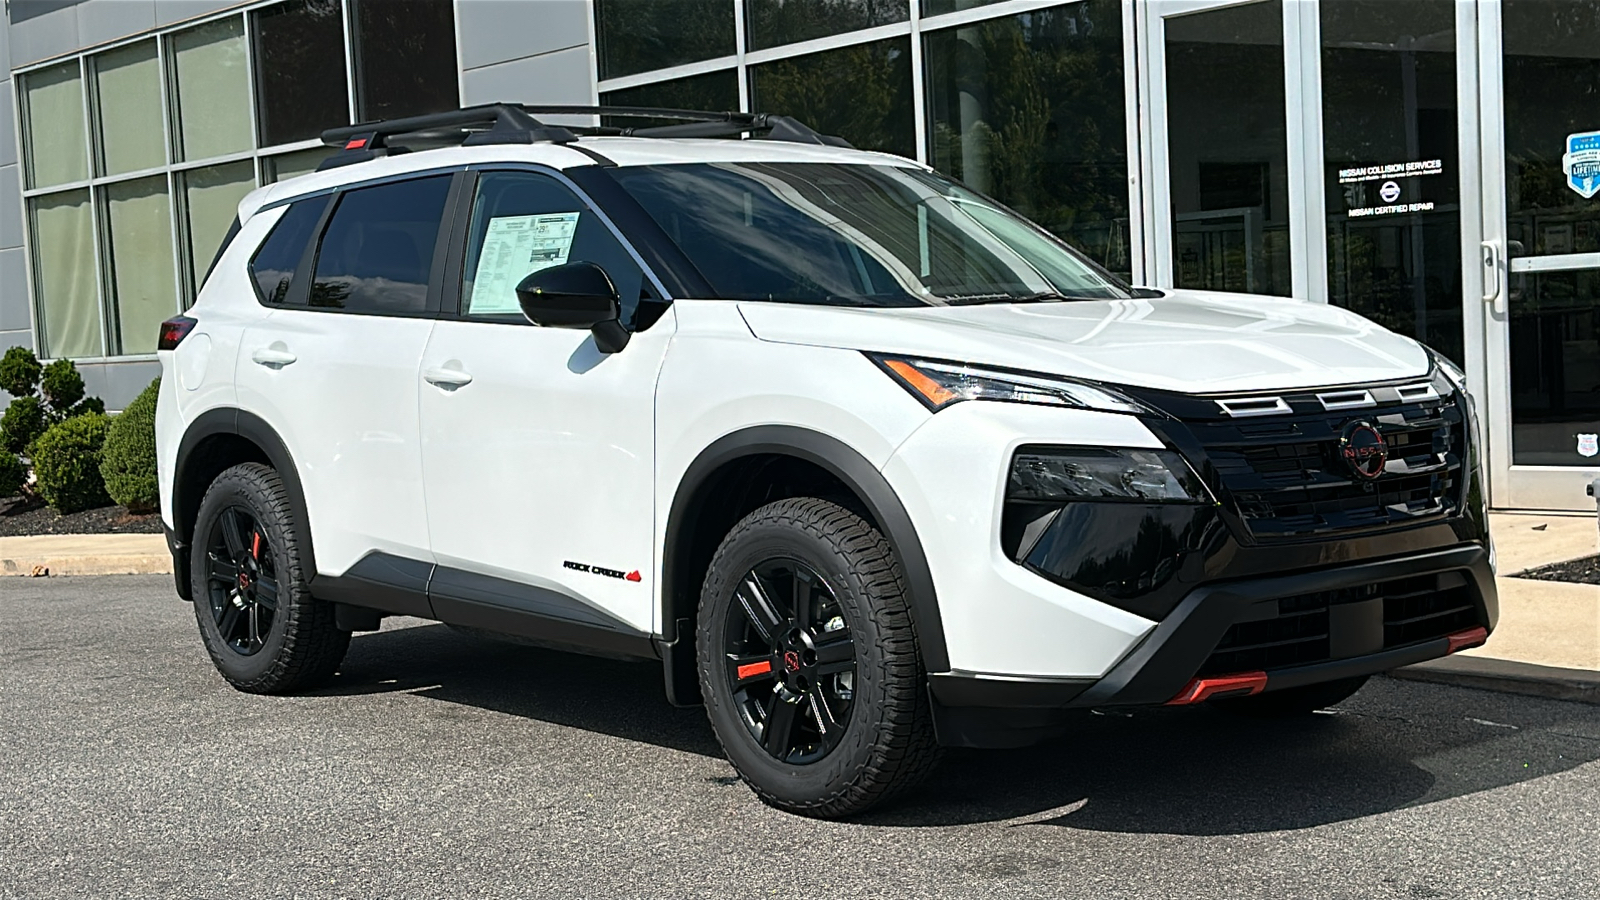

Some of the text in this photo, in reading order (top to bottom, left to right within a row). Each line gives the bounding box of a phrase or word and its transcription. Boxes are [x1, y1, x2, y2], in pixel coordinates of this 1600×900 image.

[1339, 159, 1441, 178] NISSAN COLLISION SERVICES
[1573, 165, 1600, 175] LIFETIM
[1348, 202, 1434, 217] NISSAN CERTIFIED REPAIR
[563, 560, 626, 580] ROCK CREEK
